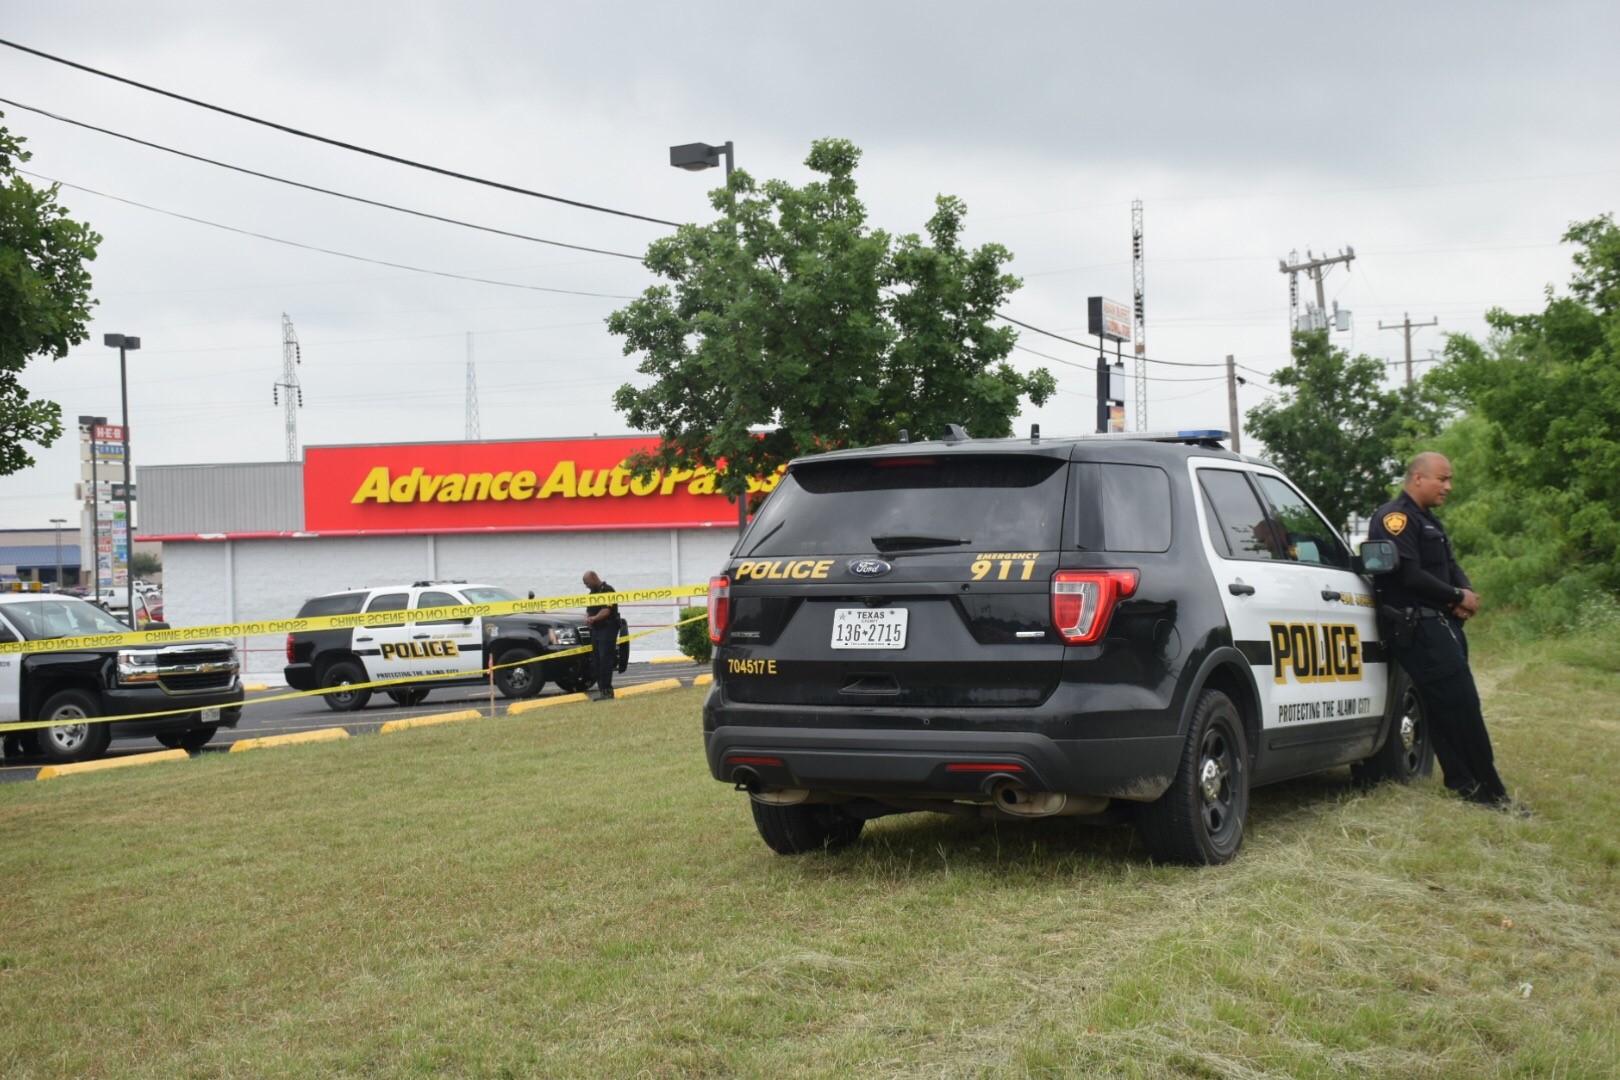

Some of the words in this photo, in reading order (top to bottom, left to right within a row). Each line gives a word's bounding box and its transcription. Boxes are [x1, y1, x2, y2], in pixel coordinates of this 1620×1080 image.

[351, 466, 537, 503] Advance
[735, 560, 835, 580] POLICE
[856, 561, 880, 573] Ford
[970, 560, 1036, 581] 911
[857, 611, 885, 619] TEXAS
[380, 639, 460, 662] POLICE
[1268, 622, 1363, 685] POLICE
[376, 671, 412, 679] PROTECTING
[728, 659, 765, 674] 704517
[768, 659, 777, 674] E
[1279, 702, 1320, 723] PROTECTING
[1322, 700, 1335, 718] THE
[1337, 698, 1356, 717] ALAMO
[1358, 698, 1370, 714] CITY
